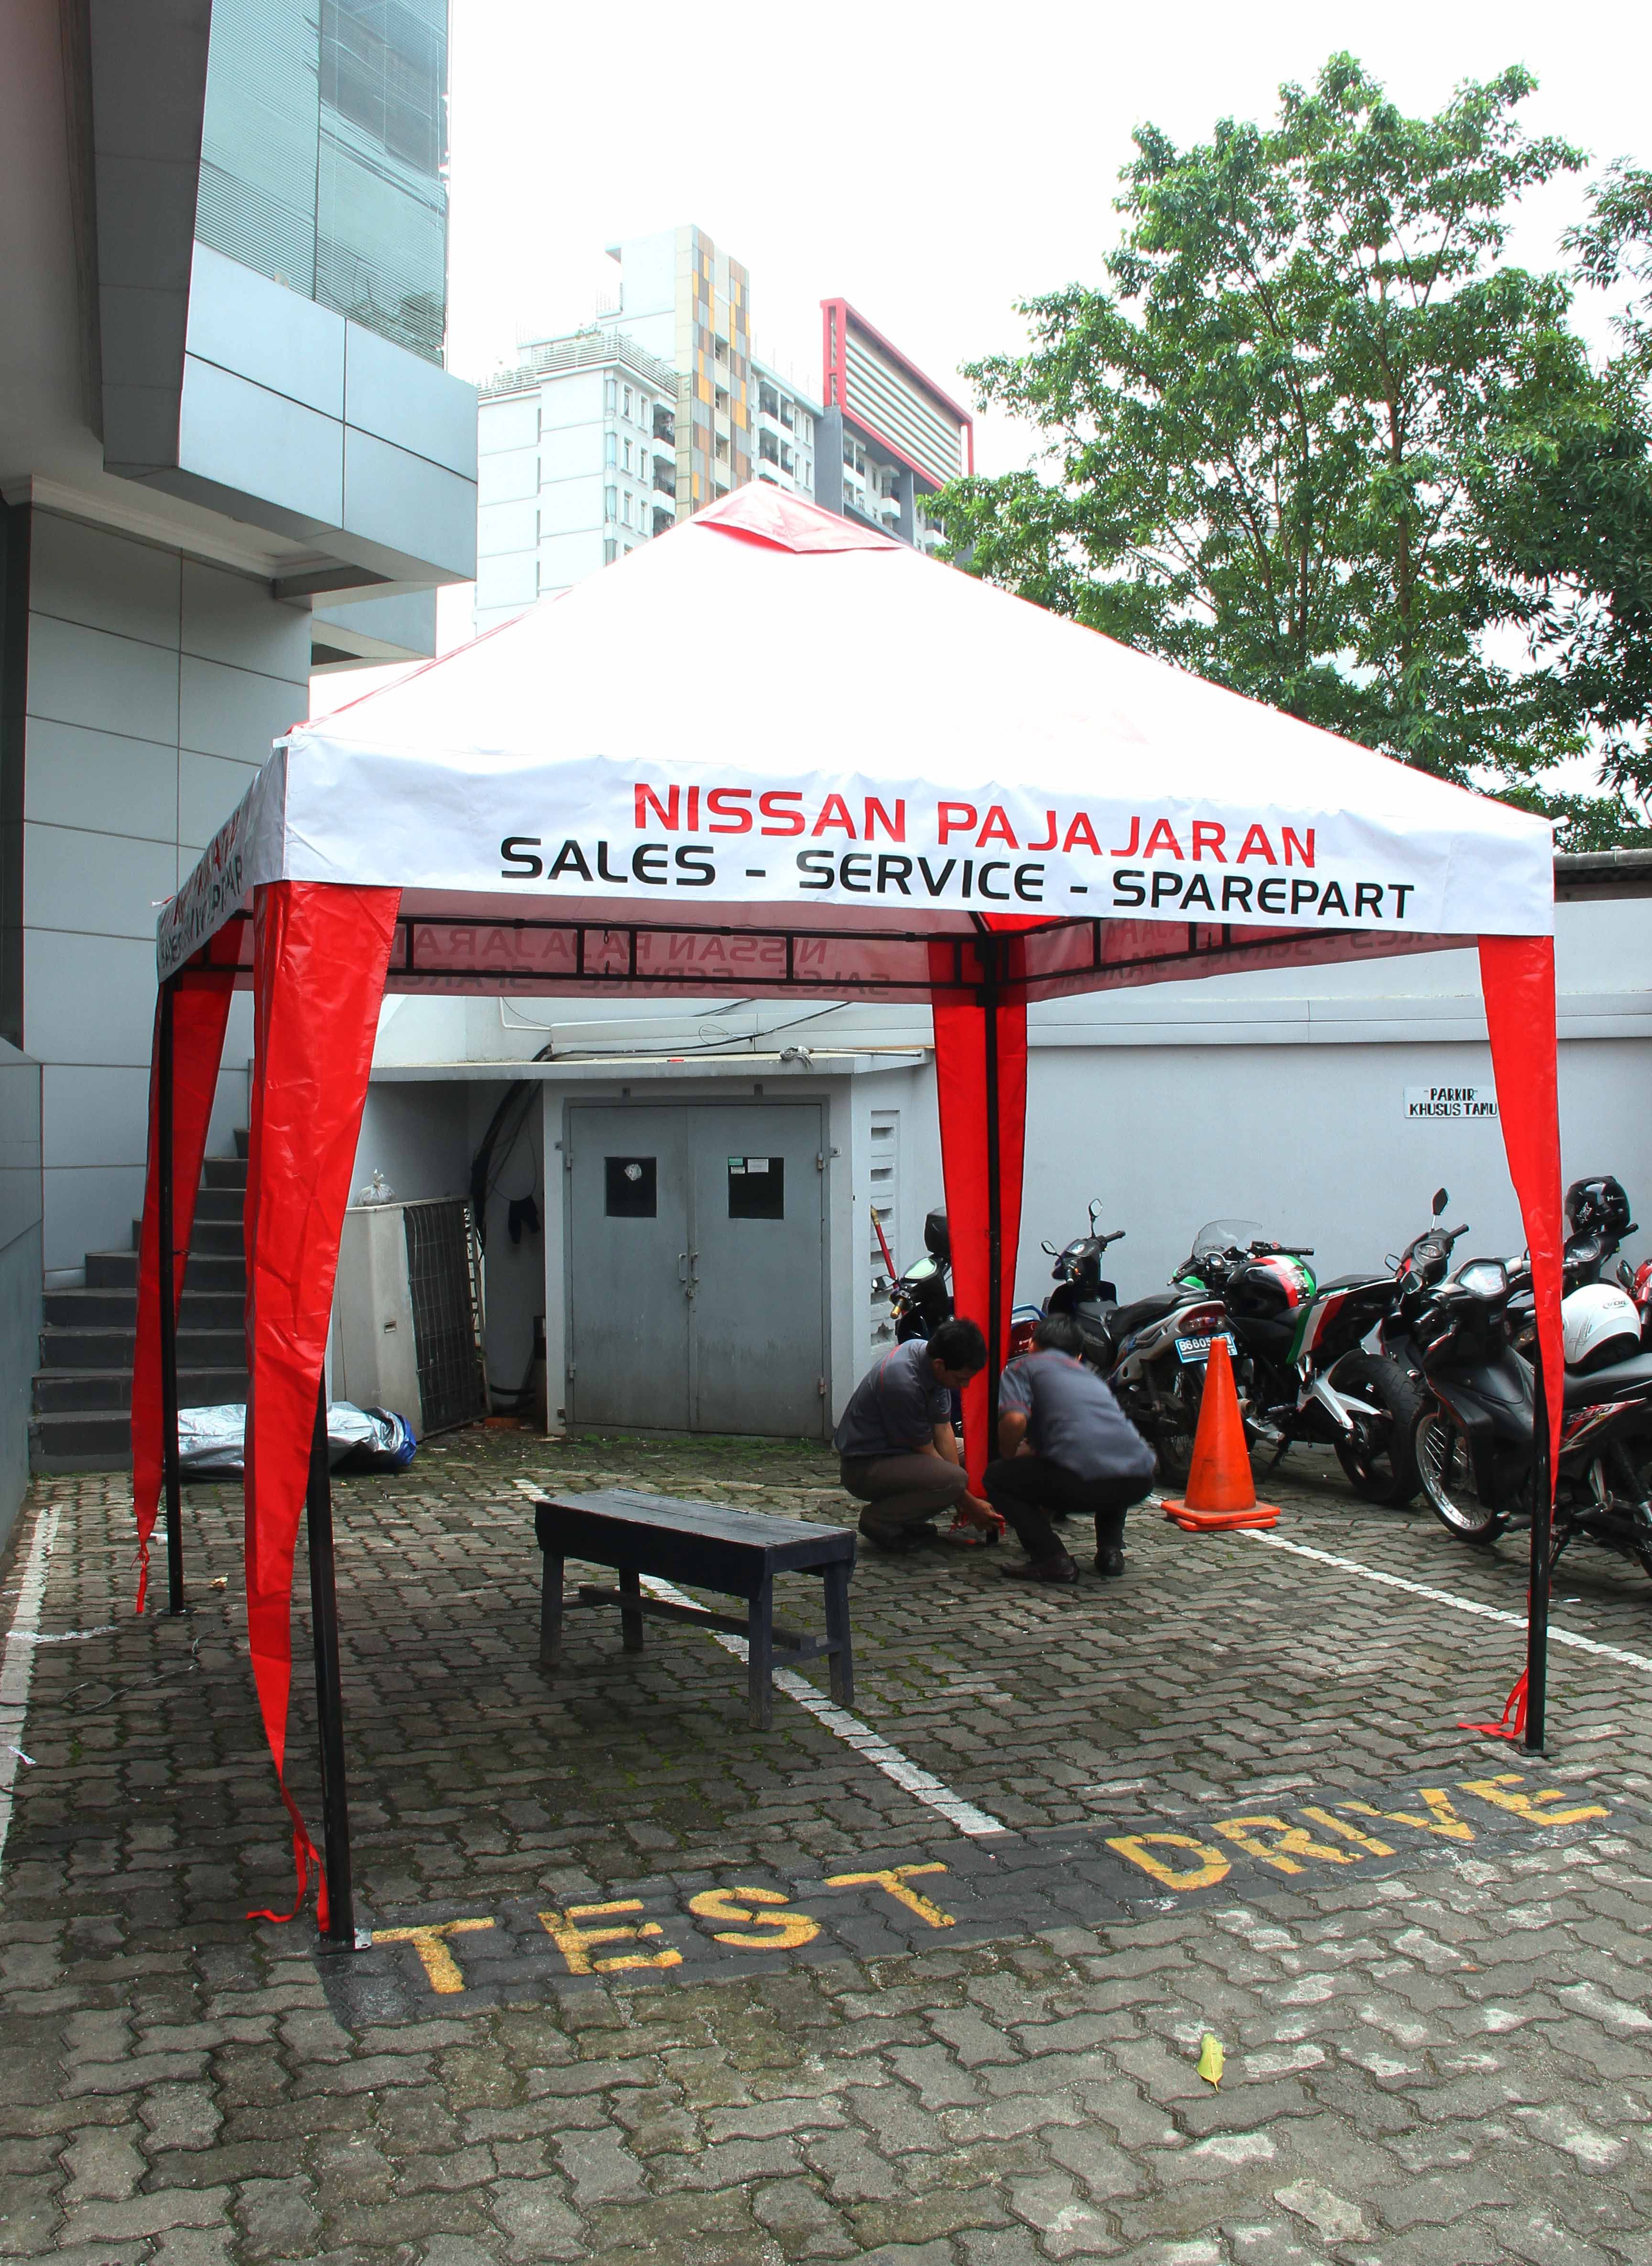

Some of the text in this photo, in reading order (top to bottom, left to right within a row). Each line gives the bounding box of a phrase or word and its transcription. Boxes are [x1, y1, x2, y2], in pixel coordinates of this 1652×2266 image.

[634, 783, 1315, 868] NISSAN PAJAJARAN
[500, 836, 716, 886] SALES
[796, 850, 1045, 902] SERVICE
[1112, 869, 1415, 919] SPAREPART
[1409, 1102, 1498, 1116] KHUSUS TAMU
[1430, 1088, 1475, 1101] PARKIR
[371, 1773, 1613, 1994] TEST DRIVE
